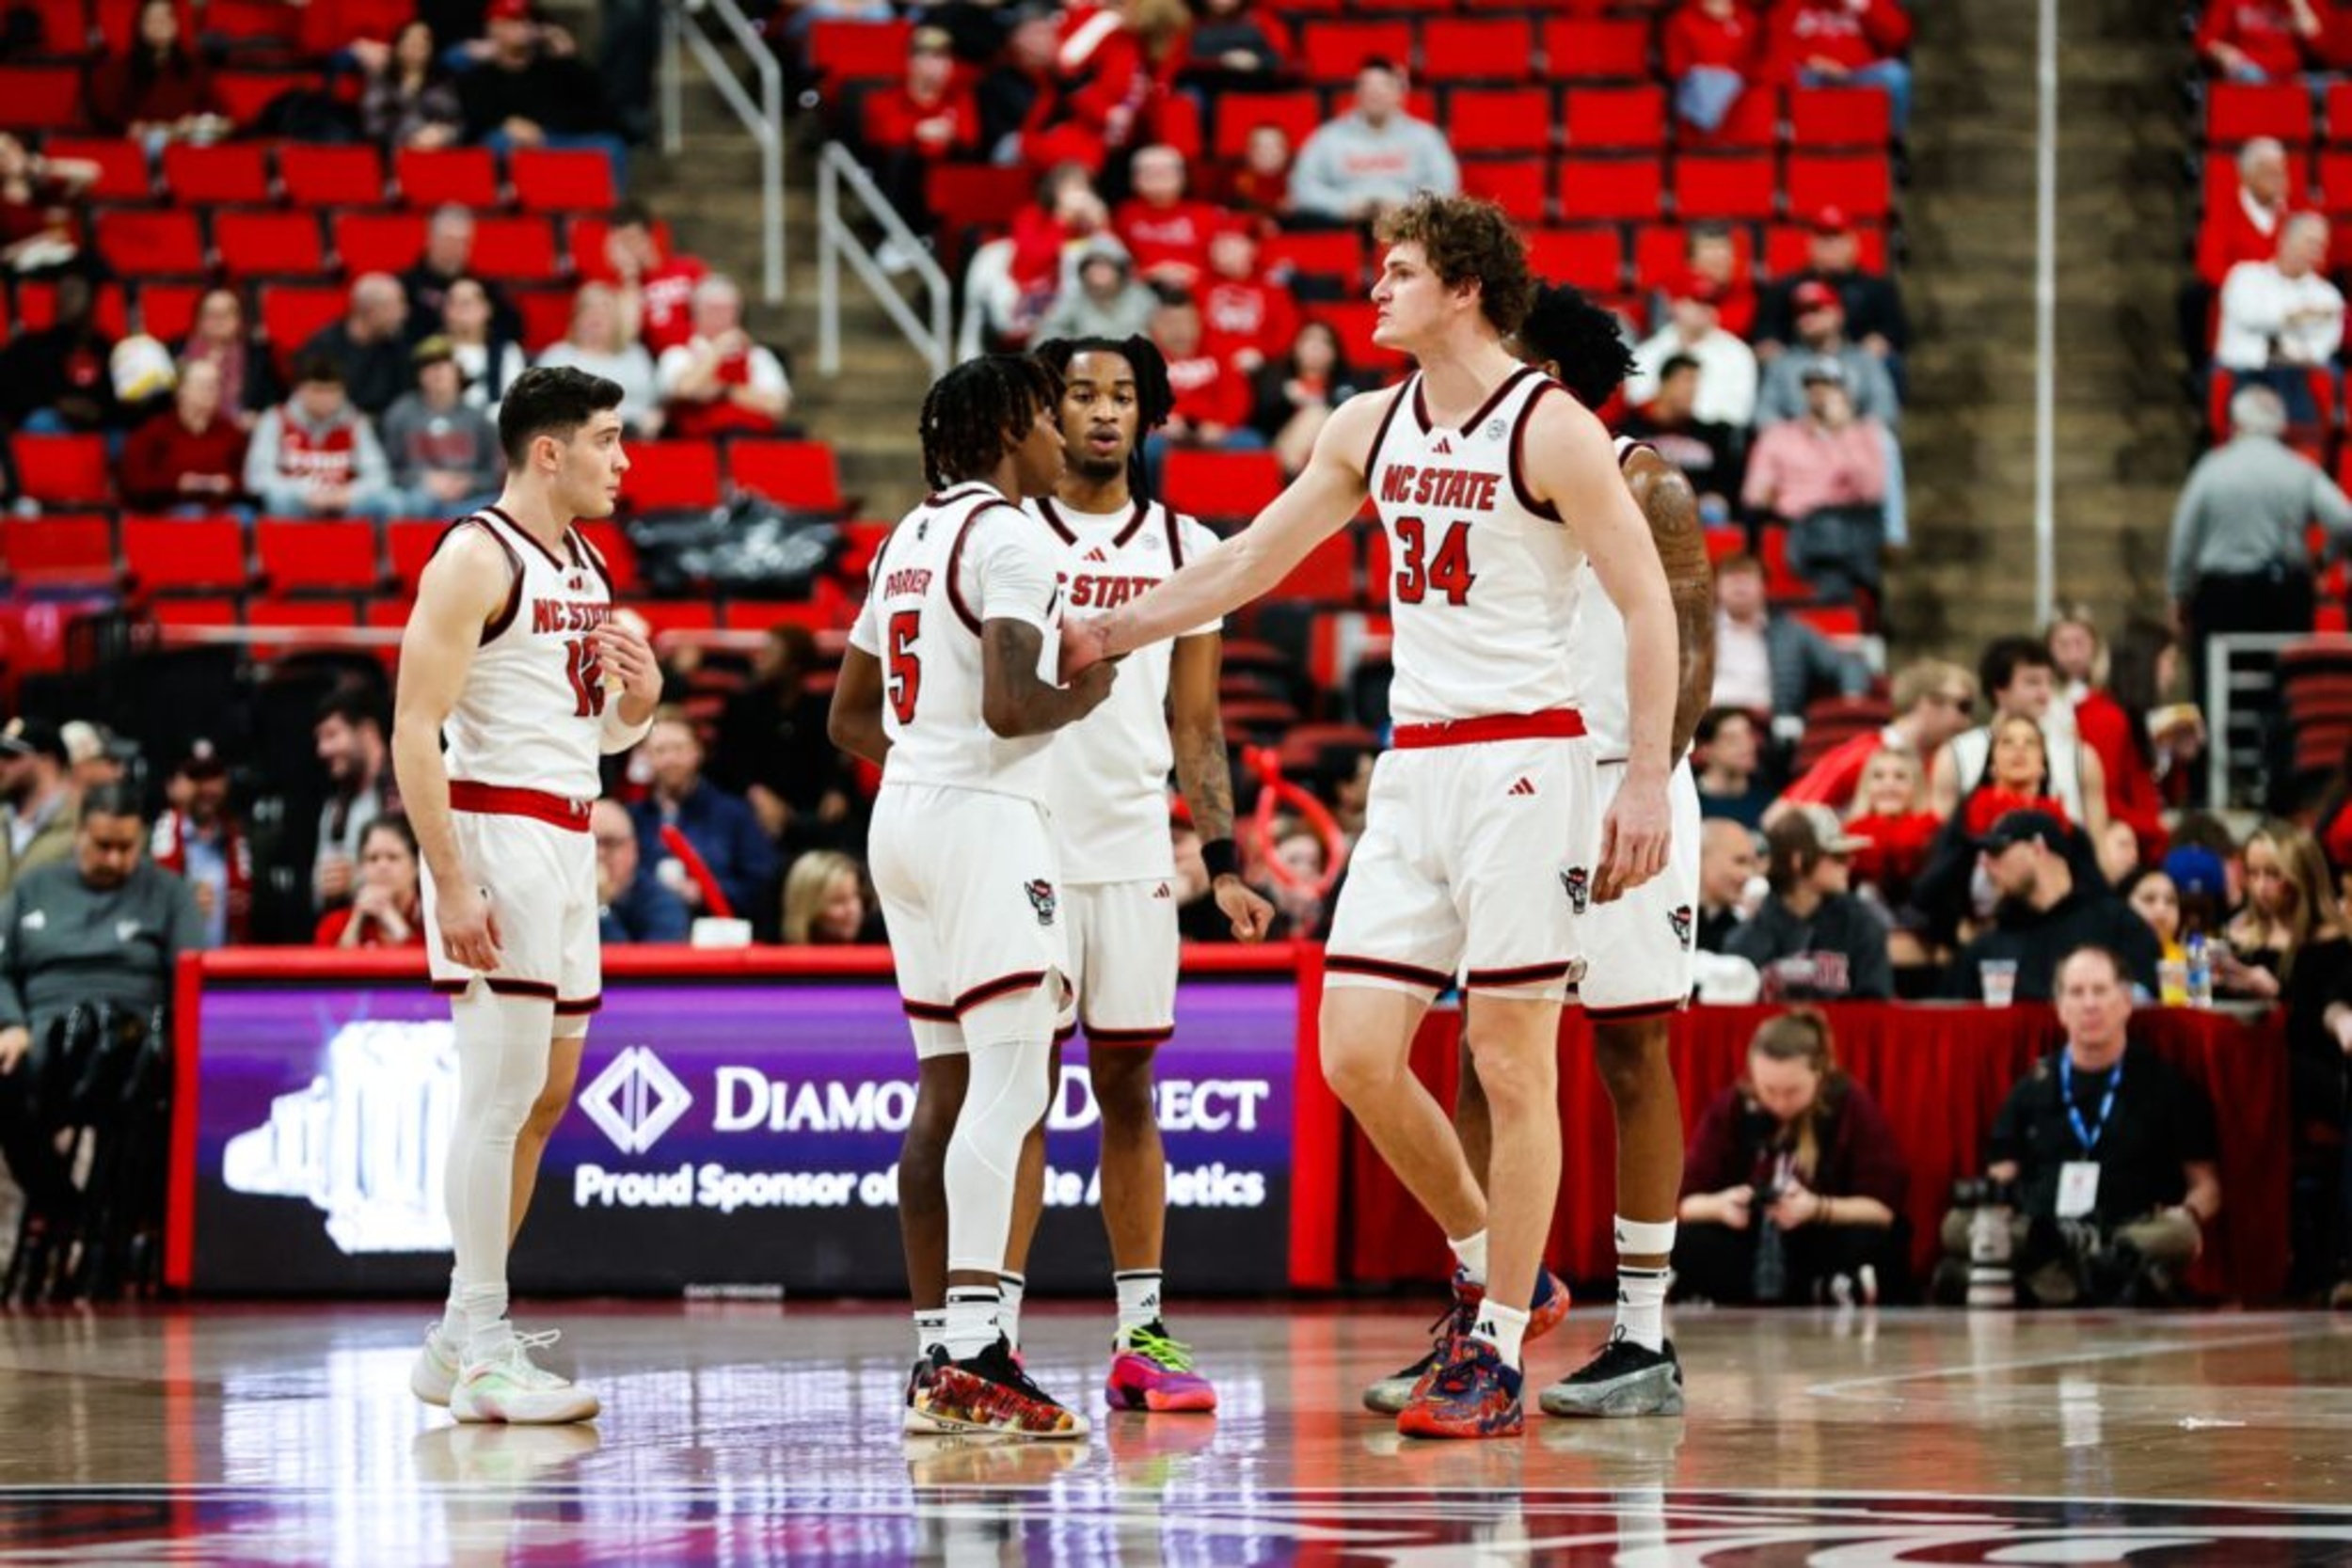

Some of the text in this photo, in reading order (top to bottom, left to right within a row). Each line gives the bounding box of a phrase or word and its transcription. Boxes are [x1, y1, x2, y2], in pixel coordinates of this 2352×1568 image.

[1380, 463, 1503, 512] NC STATE
[1394, 515, 1477, 607] 34
[532, 597, 566, 634] NC
[1070, 573, 1163, 610] STAT
[563, 635, 605, 717] 12
[888, 609, 921, 726] 5
[712, 1064, 1270, 1132] DIAMO DECT
[574, 1163, 694, 1207] Proud
[696, 1162, 858, 1214] Sponsor
